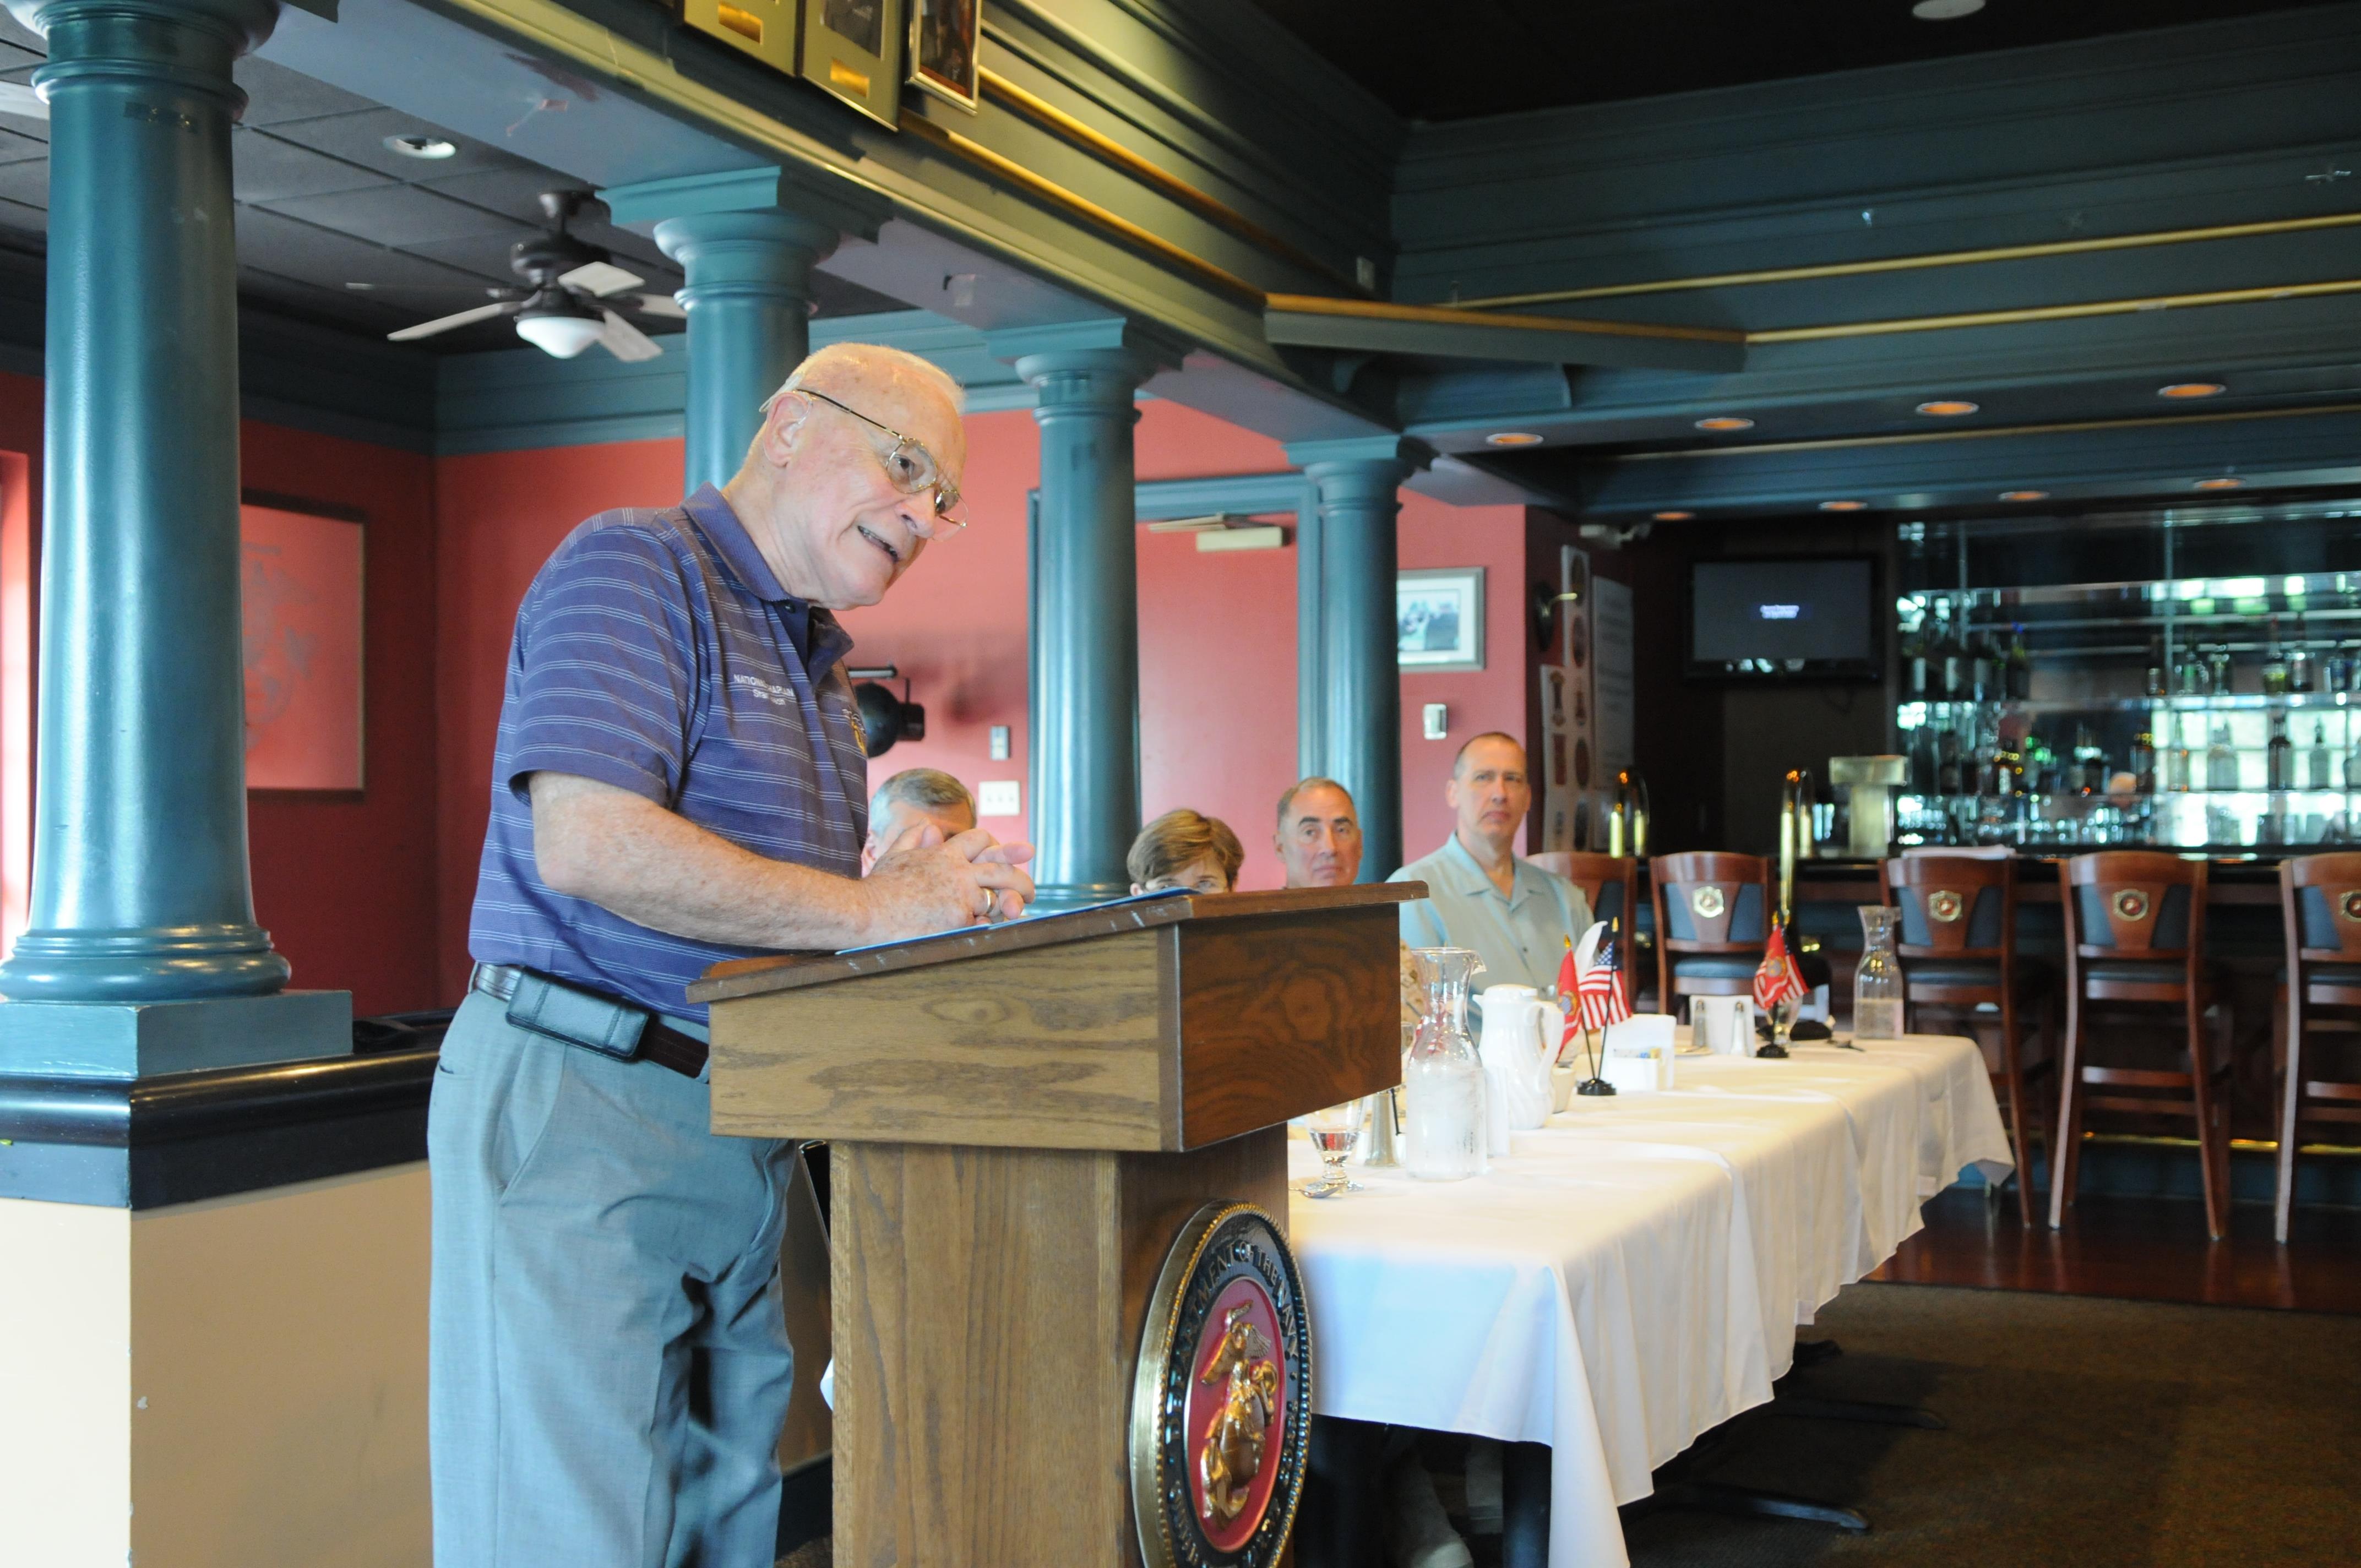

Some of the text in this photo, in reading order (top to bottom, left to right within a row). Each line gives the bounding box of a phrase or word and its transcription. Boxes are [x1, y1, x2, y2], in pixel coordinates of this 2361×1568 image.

[768, 685, 795, 696] APAIN
[1255, 1247, 1279, 1286] THE
[1276, 1276, 1299, 1359] NAVY
